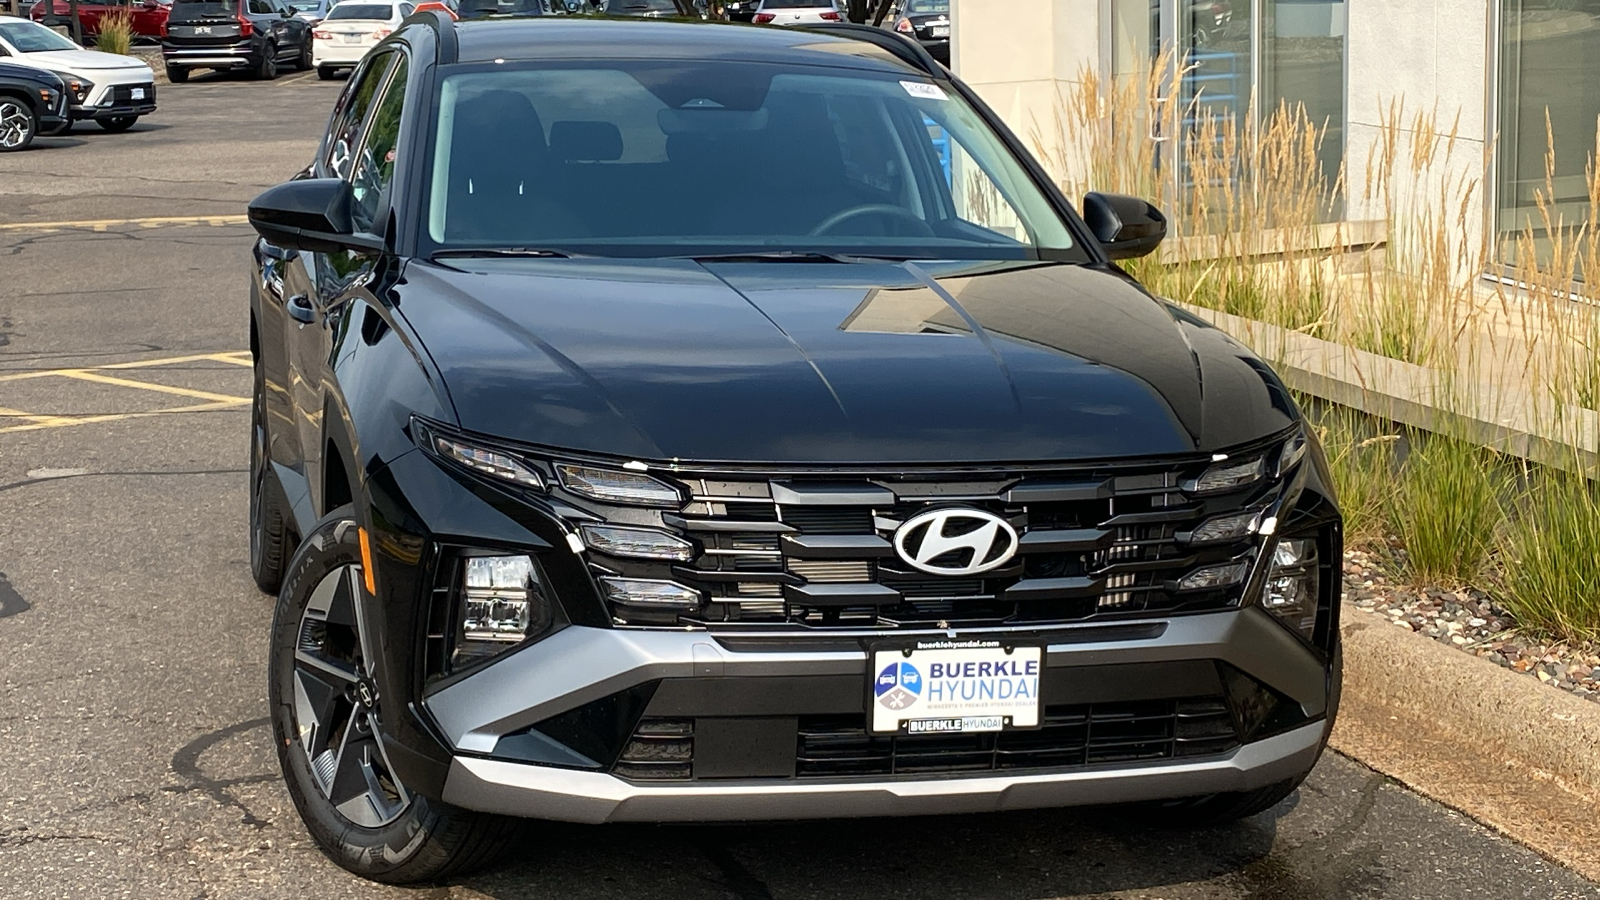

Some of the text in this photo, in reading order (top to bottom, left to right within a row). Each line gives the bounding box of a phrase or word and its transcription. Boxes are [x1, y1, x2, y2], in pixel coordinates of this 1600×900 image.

[917, 640, 1000, 649] buerklehyundai.com
[930, 660, 1038, 678] BUERKLE
[928, 678, 1038, 702] HYUNDAI
[910, 718, 1001, 732] BUERKLE HYUNDAI
